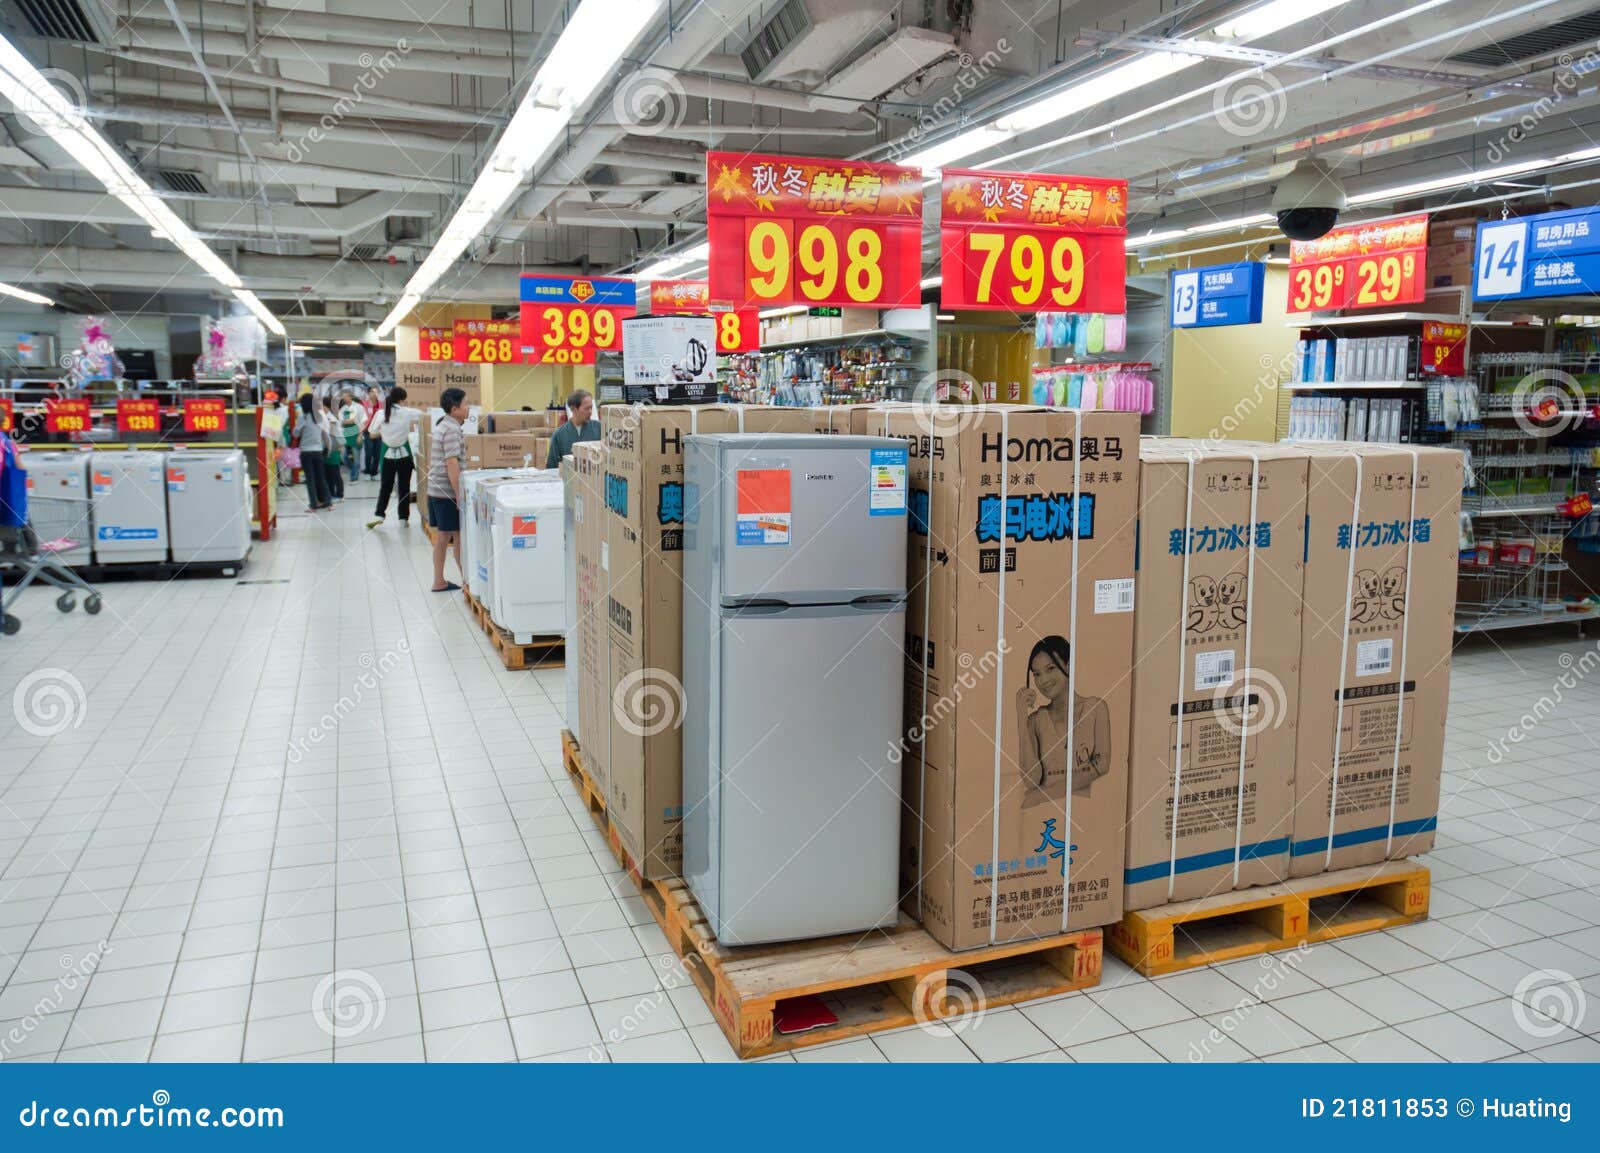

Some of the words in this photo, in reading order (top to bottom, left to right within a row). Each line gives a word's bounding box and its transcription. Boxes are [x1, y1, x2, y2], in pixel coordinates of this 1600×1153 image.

[1536, 222, 1589, 240] 厨房用品
[749, 221, 883, 302] 998
[969, 232, 1085, 306] 799
[1485, 240, 1519, 279] 14
[1534, 262, 1575, 279] 盆桶类
[1176, 285, 1194, 312] 13
[543, 308, 615, 347] 399
[468, 338, 512, 362] 268
[403, 372, 436, 385] Haier
[445, 372, 478, 384] Haier
[981, 432, 1072, 463] Homa
[1080, 437, 1123, 461] 奥马
[976, 493, 1096, 543] 奥马电冰箱
[1168, 521, 1271, 556] 新力冰箱
[1336, 518, 1431, 550] 新力冰箱
[981, 551, 1016, 571] 前面
